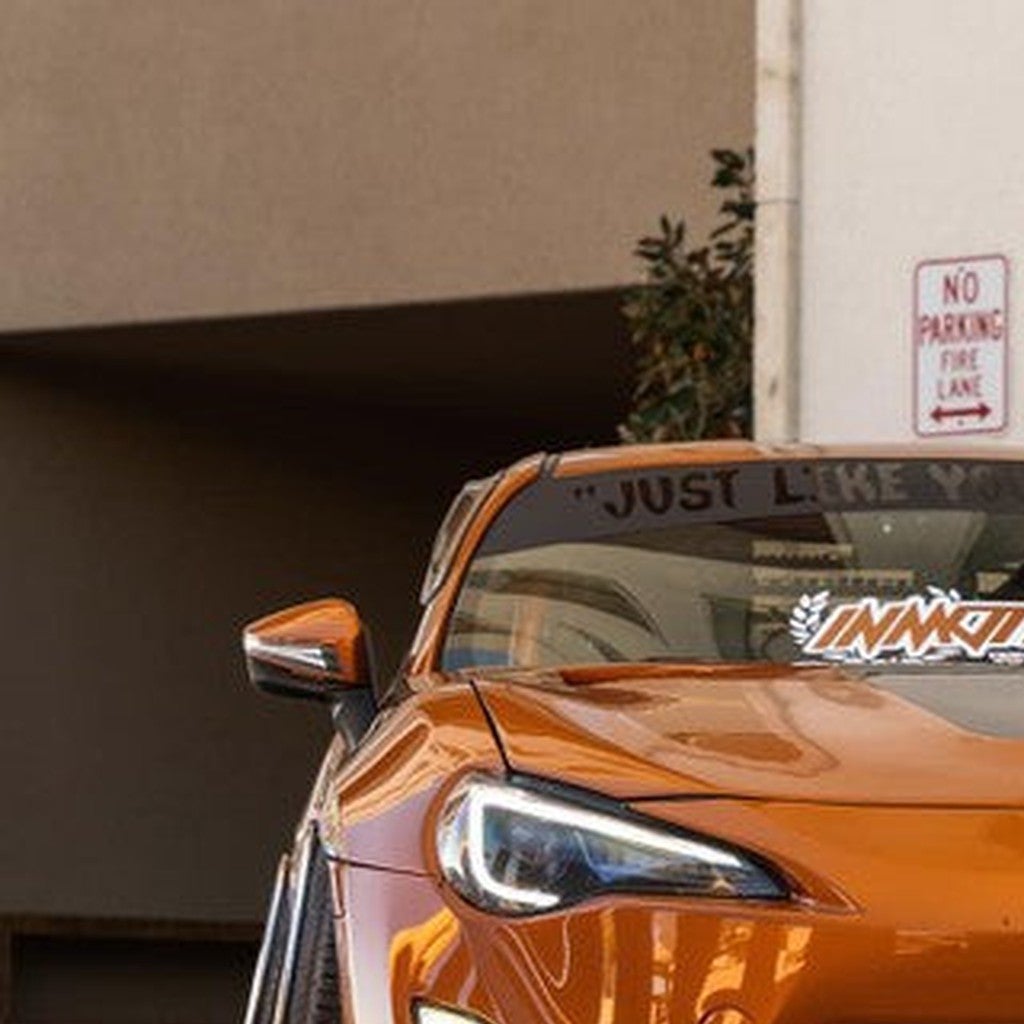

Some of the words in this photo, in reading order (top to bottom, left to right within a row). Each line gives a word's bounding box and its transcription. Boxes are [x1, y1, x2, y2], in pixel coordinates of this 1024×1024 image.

[943, 270, 980, 304] NO
[920, 310, 1003, 347] PARKING
[940, 348, 980, 371] FIRE
[937, 374, 983, 401] LANE
